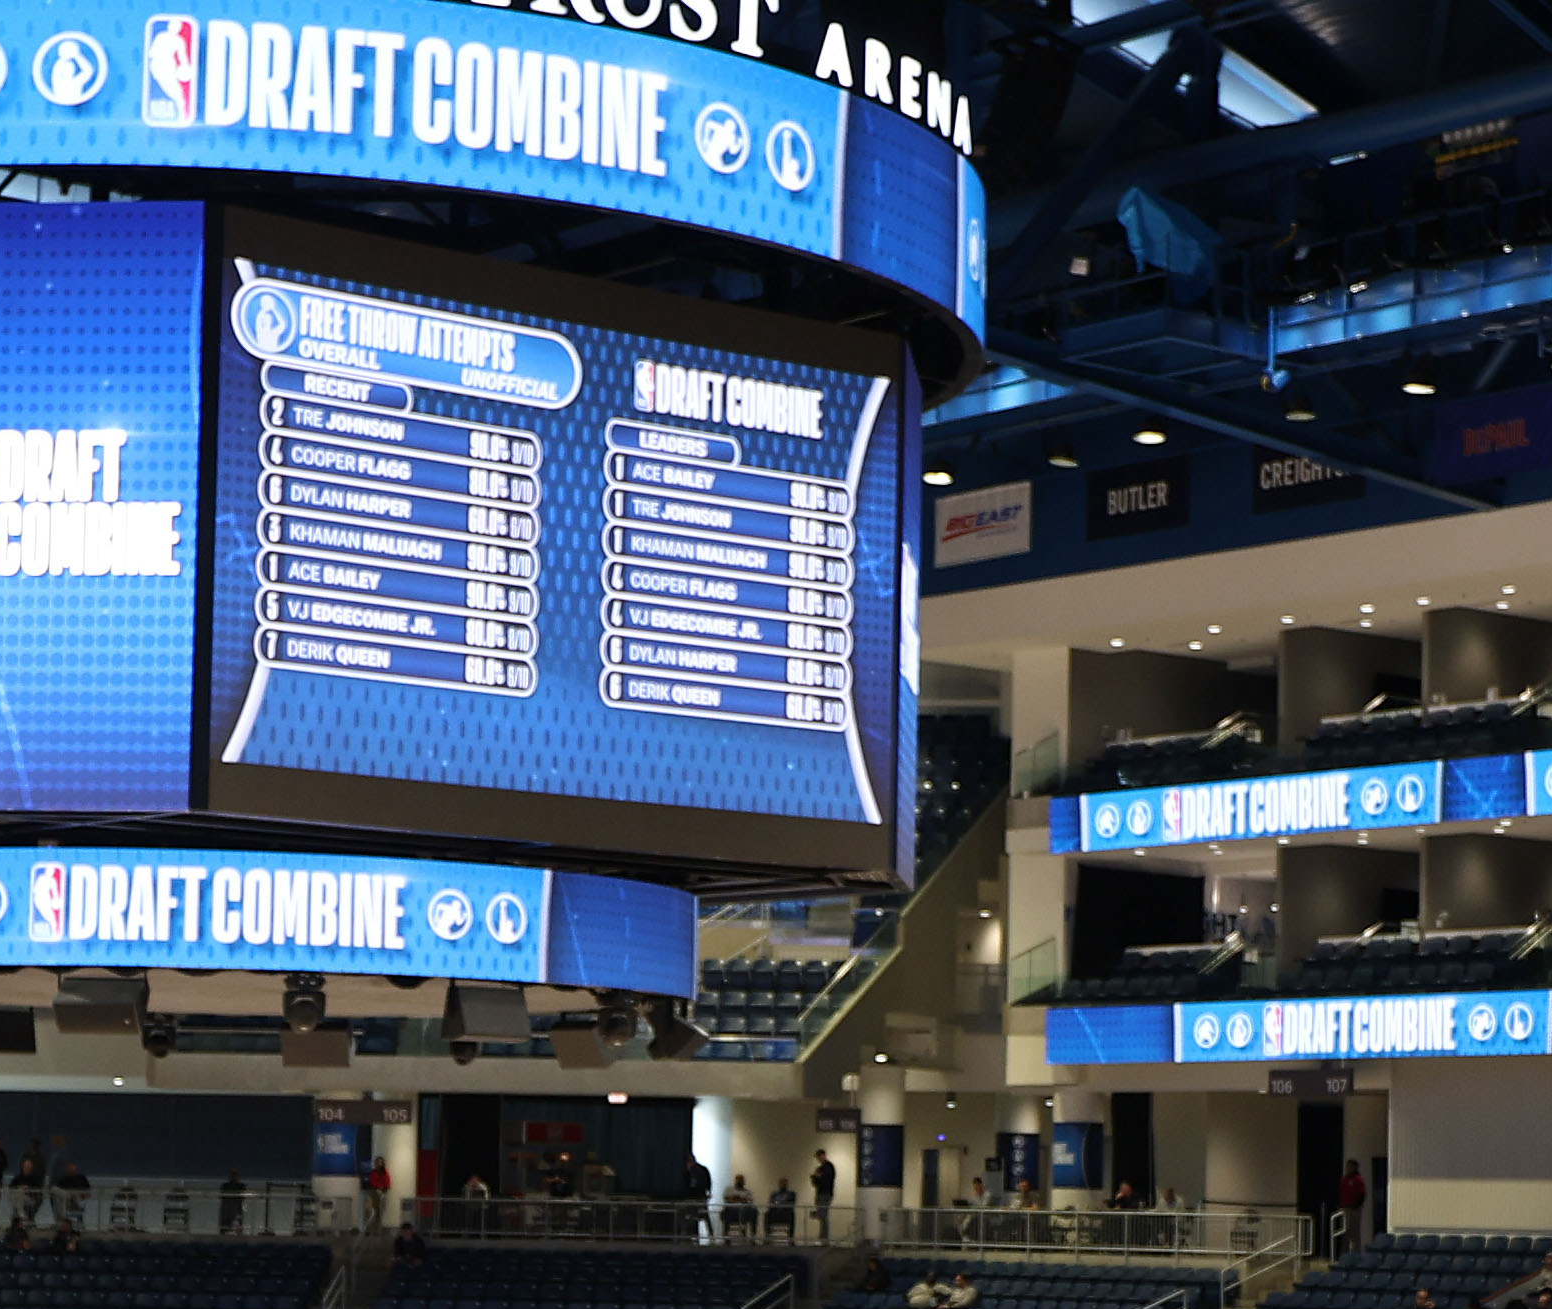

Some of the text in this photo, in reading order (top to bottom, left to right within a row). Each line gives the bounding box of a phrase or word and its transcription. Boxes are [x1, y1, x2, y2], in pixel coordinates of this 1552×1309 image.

[205, 20, 405, 137] DRAFT
[412, 37, 667, 177] COMBINE
[816, 21, 972, 155] ARENA
[300, 296, 516, 372] FREE THROW ATTEMPTS
[299, 339, 381, 370] OVERALL
[304, 374, 372, 402] RECENT
[461, 368, 559, 399] UNOFFICIAL
[655, 363, 824, 440] DRAFT COMBINE
[272, 397, 284, 425] 2
[294, 407, 323, 428] TRE
[326, 412, 405, 441] JOHNSON
[639, 430, 708, 458] LEADERS
[292, 446, 356, 472] COOPER
[357, 455, 412, 480] FLAGG
[633, 463, 715, 490] ACE BAILEY
[1260, 457, 1346, 490] CREIGH
[291, 484, 345, 510] DYLAN
[346, 490, 412, 518] HARPER
[1107, 481, 1168, 515] BUTLER
[633, 500, 732, 530] TRE JOHNSON
[290, 524, 361, 551] KHAMAN
[363, 531, 442, 562] MALUACH
[631, 534, 768, 569] KHAMAN MALUACH
[289, 562, 321, 583] ACE
[323, 566, 381, 591] BAILEY
[630, 572, 738, 601] COOPER FLAGG
[288, 600, 308, 619] VJ
[311, 604, 409, 634] EDGECOMBE
[410, 615, 437, 636] JR.
[630, 608, 763, 640] VJ EDGECOMBE JR.
[287, 639, 333, 661] DERIK
[336, 644, 391, 669] QUEEN
[629, 643, 738, 673] DYLAN HARPER
[628, 680, 722, 708] DERIK QUEEN
[1183, 773, 1351, 839] DRAFT COMBINE
[68, 864, 407, 950] DRAFT COMBINE
[1282, 997, 1456, 1054] DRAFT COMBINE
[1271, 1079, 1347, 1094] 106 107
[318, 1108, 408, 1121] 104 105
